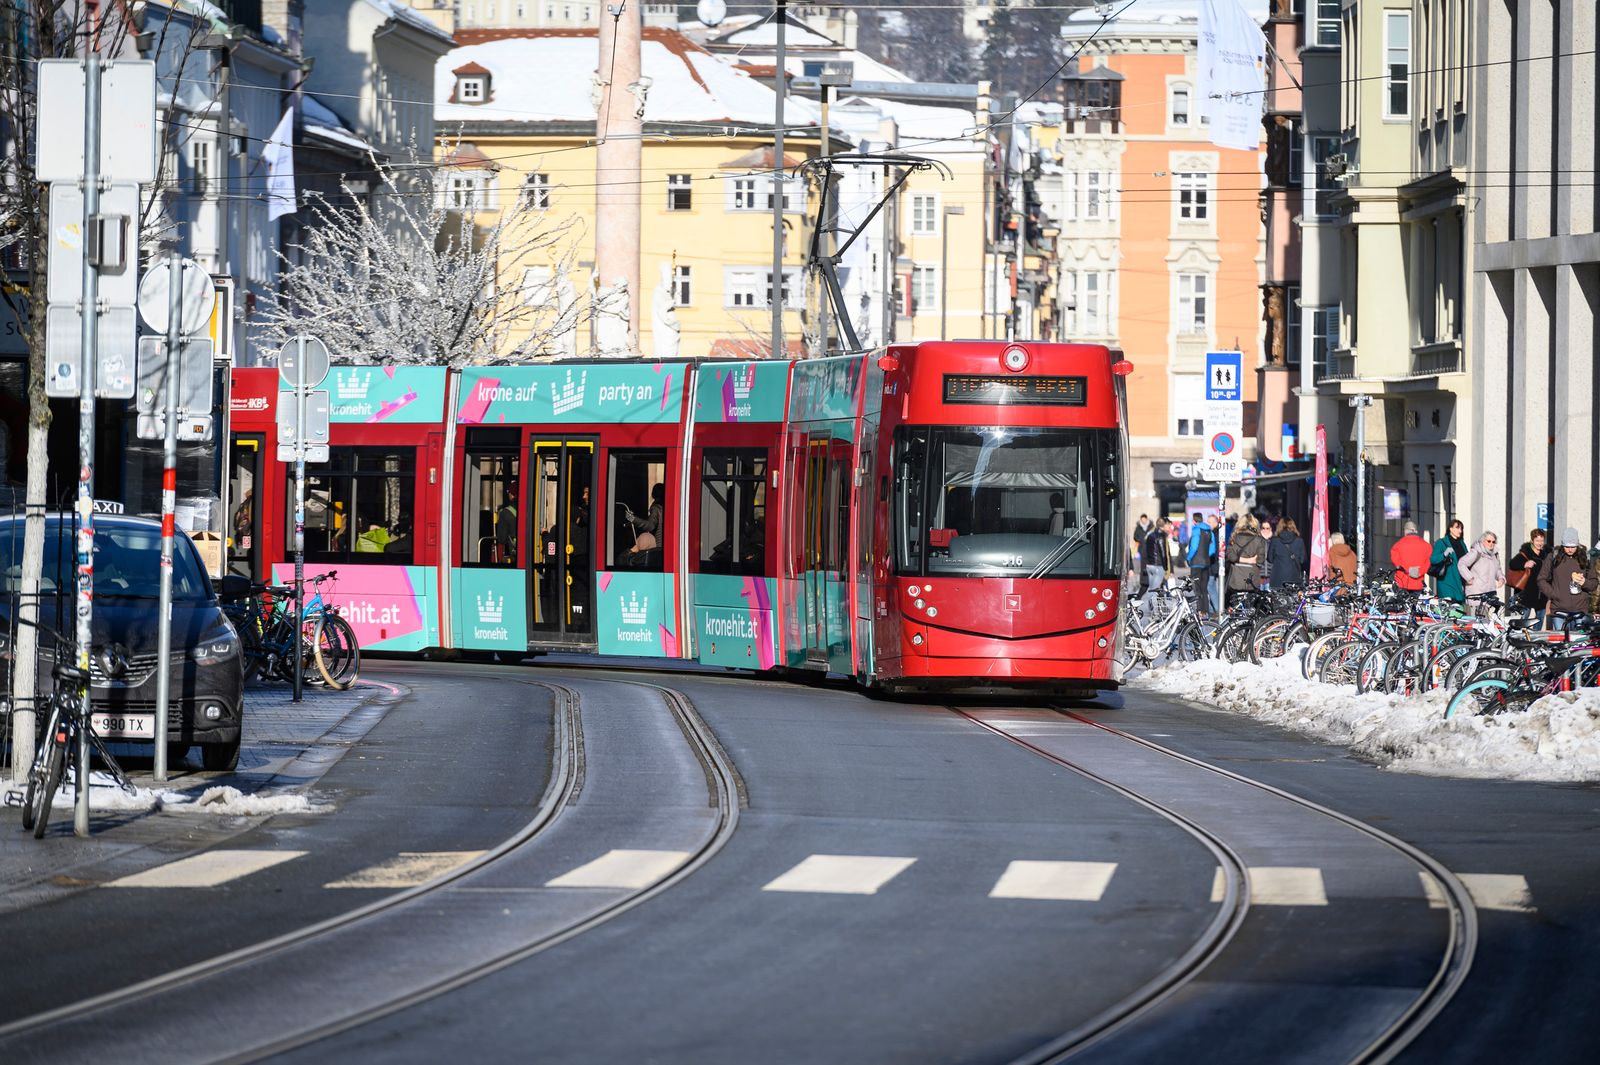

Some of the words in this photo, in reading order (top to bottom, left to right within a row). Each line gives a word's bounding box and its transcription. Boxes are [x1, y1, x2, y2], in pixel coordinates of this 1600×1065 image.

[478, 382, 512, 402] krone
[515, 382, 538, 401] auf
[599, 383, 634, 406] party
[636, 384, 653, 400] an
[330, 402, 372, 416] kronehit
[728, 402, 752, 416] kronehit
[1208, 459, 1237, 471] Zone
[90, 501, 118, 514] AXI
[339, 600, 401, 625] ehit.at
[705, 611, 758, 639] kronehit.at
[474, 627, 508, 641] kronehit
[617, 628, 653, 642] kronehit
[102, 718, 126, 731] 990
[128, 719, 144, 731] TX
